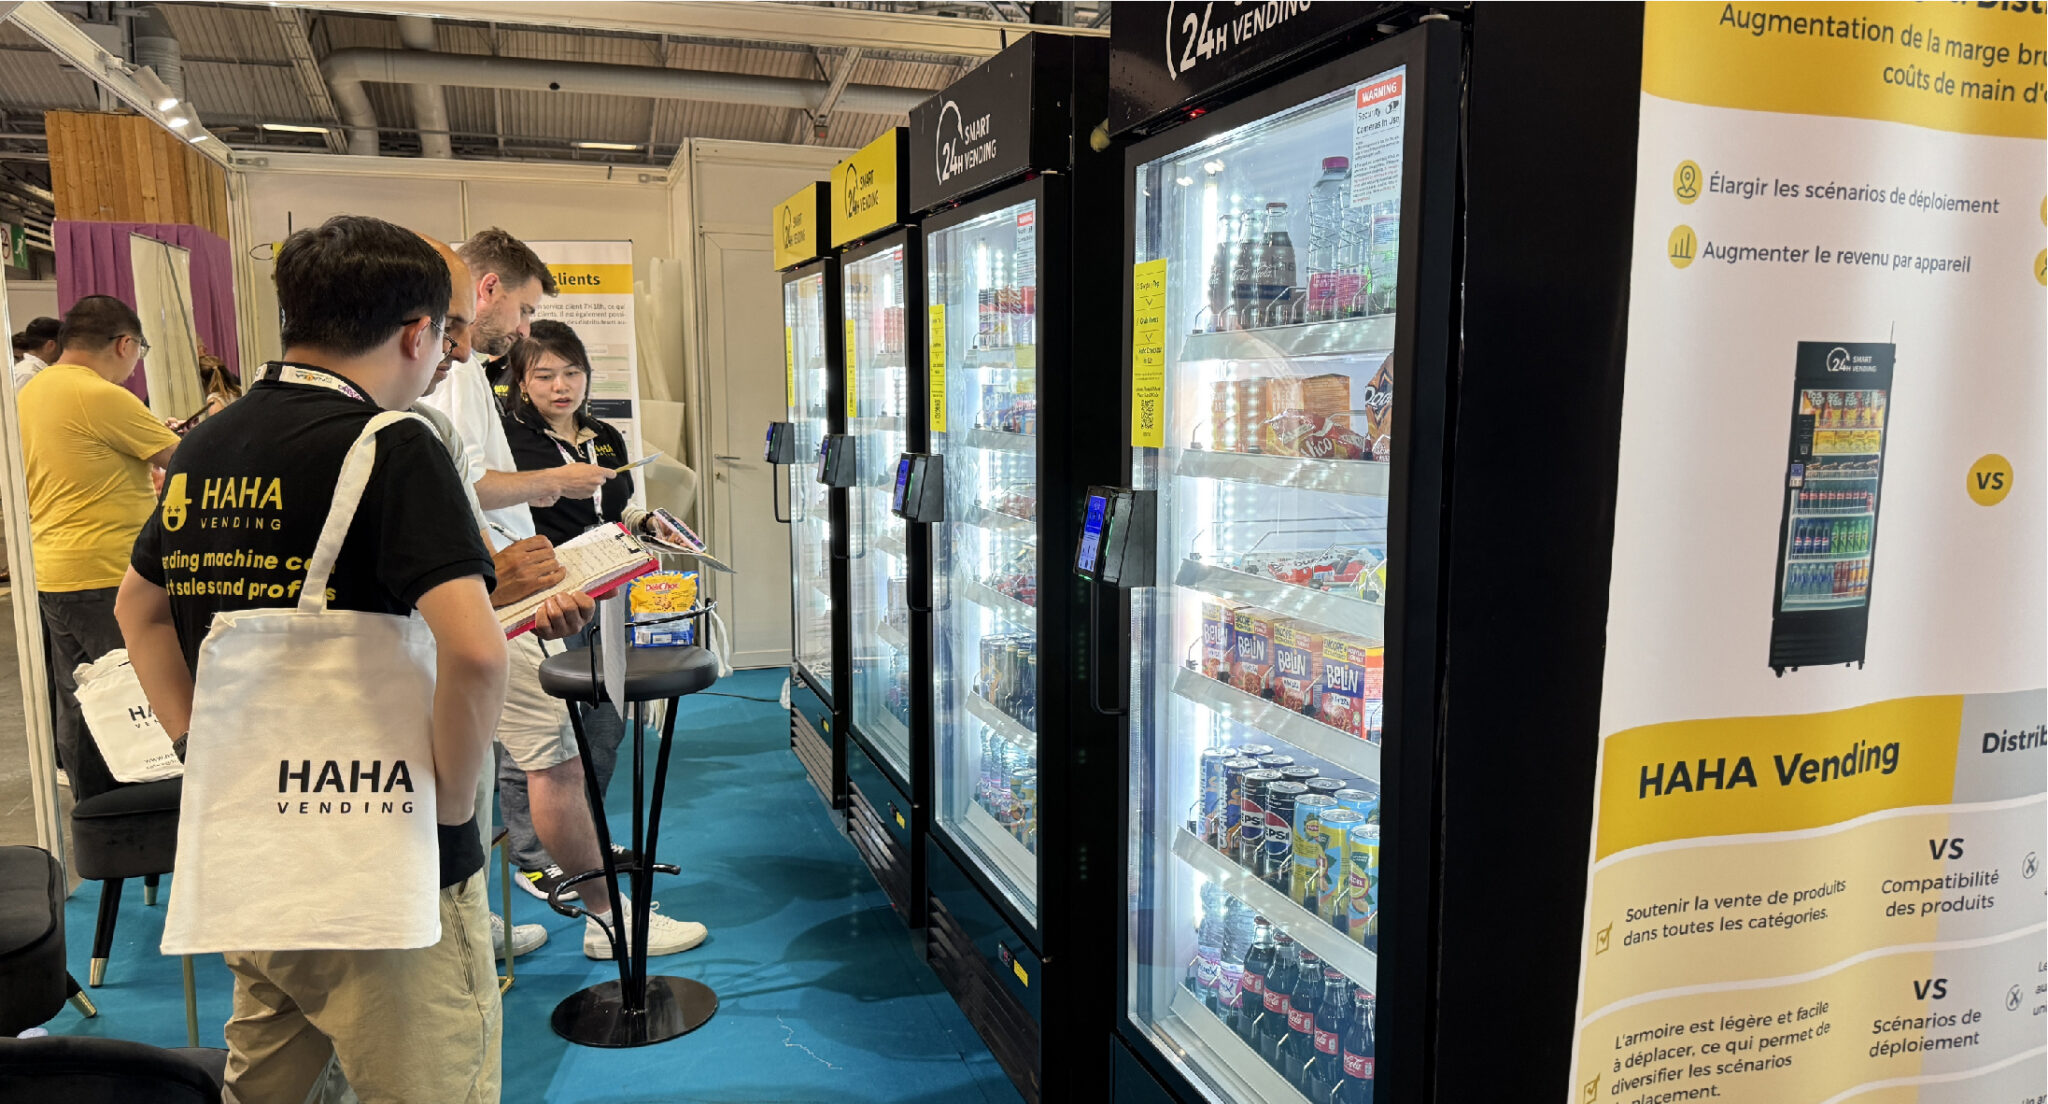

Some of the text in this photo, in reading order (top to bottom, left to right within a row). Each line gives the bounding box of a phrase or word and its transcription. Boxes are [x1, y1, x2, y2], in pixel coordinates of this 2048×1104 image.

[1720, 3, 1894, 44] Augmentation
[1900, 24, 1922, 48] de
[1927, 28, 1940, 53] la
[1945, 39, 2010, 67] marge
[1361, 82, 1397, 103] WARNING
[1883, 64, 2047, 103] coûts de main d'
[964, 113, 991, 146] SMART
[964, 138, 997, 171] VENDING
[1709, 170, 2000, 215] Élargir les scénarios de déploiement
[1703, 241, 1971, 274] Augmenter le revenu par appareil
[201, 477, 283, 510] HAHA
[1976, 472, 2004, 490] VS
[201, 516, 281, 530] VENDING
[203, 549, 278, 570] machine
[176, 577, 216, 596] sales
[249, 580, 336, 601] profs
[278, 760, 414, 793] HAHA
[1639, 739, 1900, 799] HAHA Vending
[277, 801, 414, 814] VENDING
[1929, 838, 1964, 860] VS
[1881, 869, 2000, 895] Compatibilité
[1625, 879, 1846, 924] Soutenir la vente de produits
[1885, 893, 1995, 919] des produits
[1623, 905, 1829, 947] dans toutes les catégories.
[1913, 978, 1948, 1001] VS
[1615, 1001, 1829, 1050] L'armoire est légère et facile
[1872, 1008, 1982, 1035] Scénarios de
[1613, 1021, 1831, 1073] à déplacer, ce qui permet de
[1868, 1030, 1980, 1058] déploiement
[1611, 1054, 1792, 1095] diversifier les scénarios
